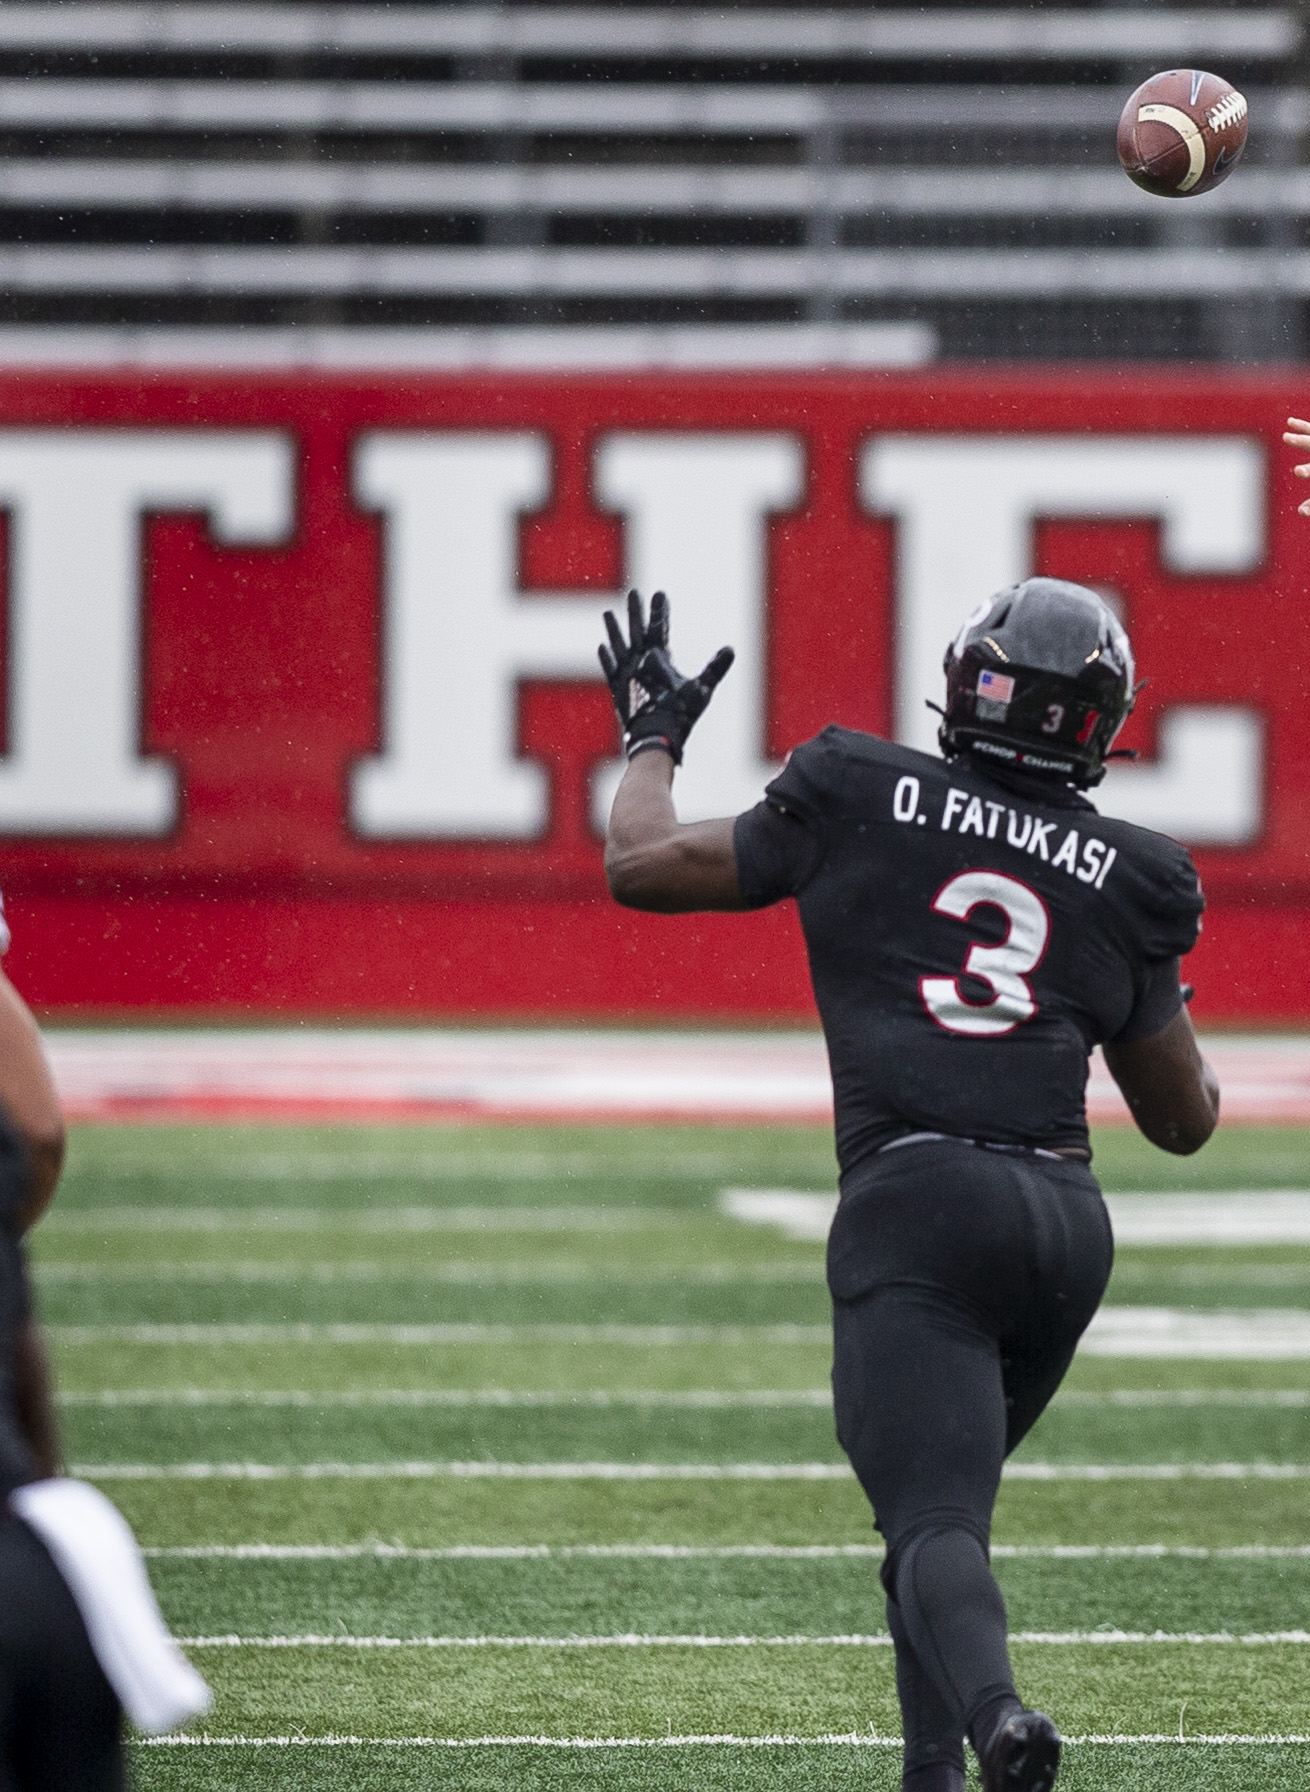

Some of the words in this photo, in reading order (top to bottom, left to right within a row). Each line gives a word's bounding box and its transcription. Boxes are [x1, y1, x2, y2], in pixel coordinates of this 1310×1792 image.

[0, 430, 1265, 840] THE
[1041, 703, 1066, 733] 3
[893, 775, 927, 825] O.
[940, 787, 1117, 890] FATUKASI
[918, 867, 1053, 1038] 3
